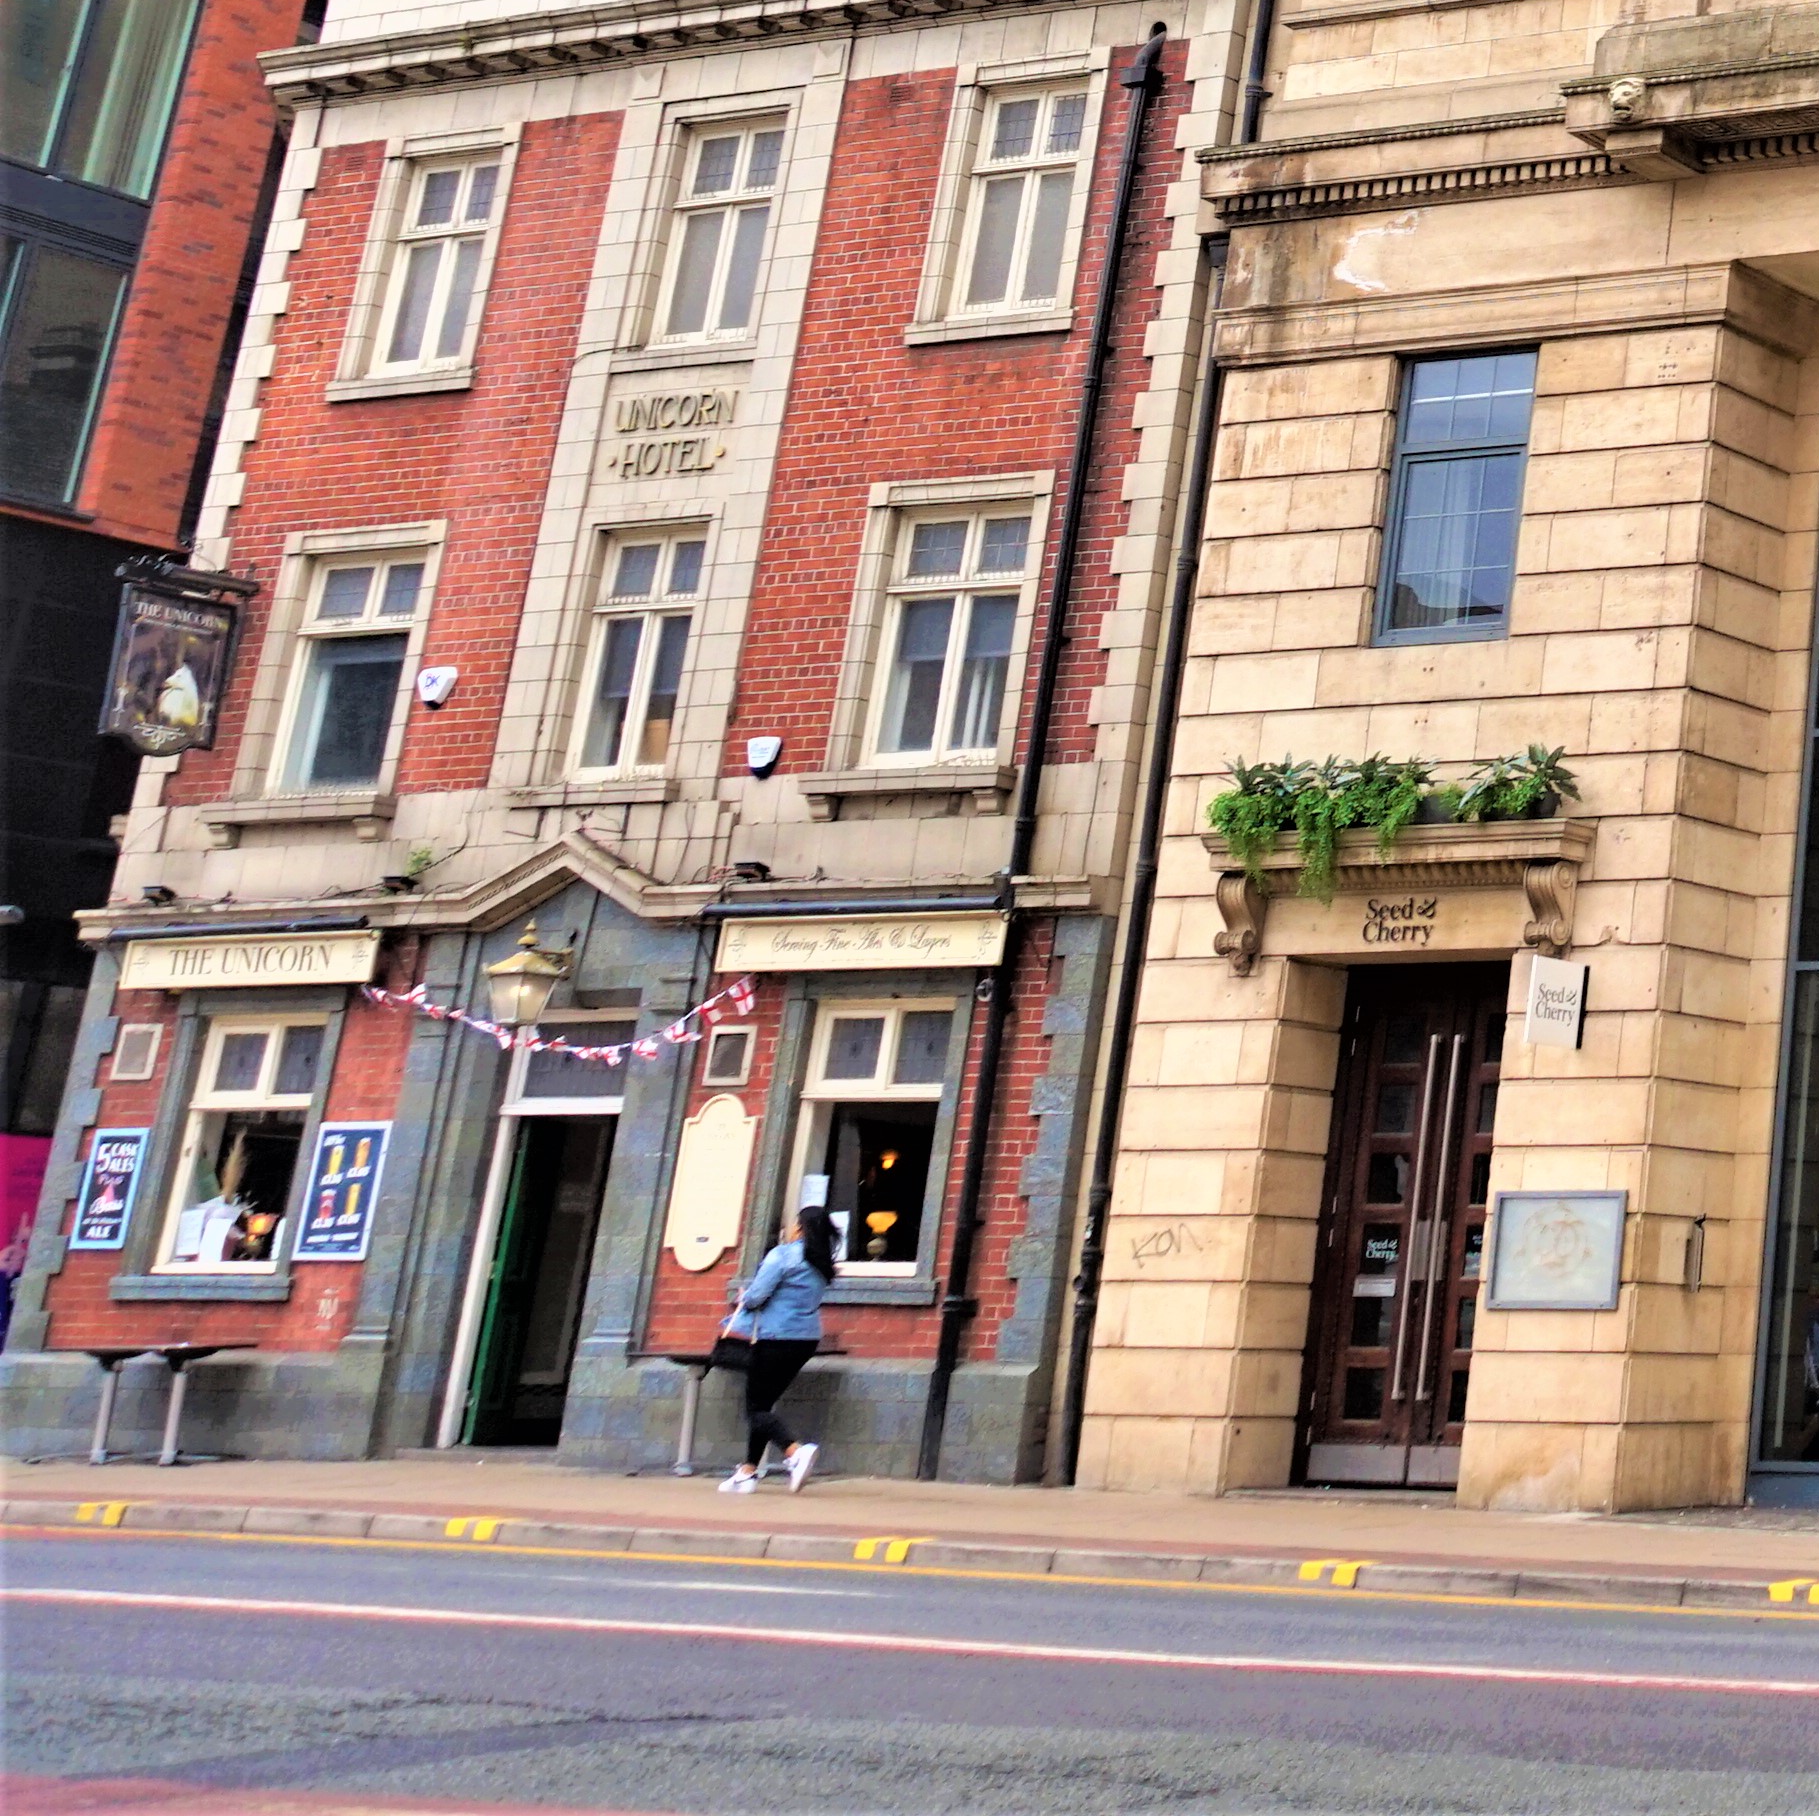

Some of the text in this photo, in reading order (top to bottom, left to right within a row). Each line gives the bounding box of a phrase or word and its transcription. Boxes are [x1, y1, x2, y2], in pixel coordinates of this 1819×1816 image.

[615, 389, 739, 433] UNICORN
[1366, 897, 1414, 920] Seed
[1362, 920, 1434, 947] Cherry
[169, 943, 336, 976] THE UNICORN
[1538, 983, 1566, 1003] Seed
[1536, 1001, 1576, 1027] Cherry
[95, 1143, 112, 1173] 5
[84, 1225, 114, 1239] ALE
[1365, 1248, 1397, 1261] Cherry
[1366, 1238, 1388, 1251] Seed
